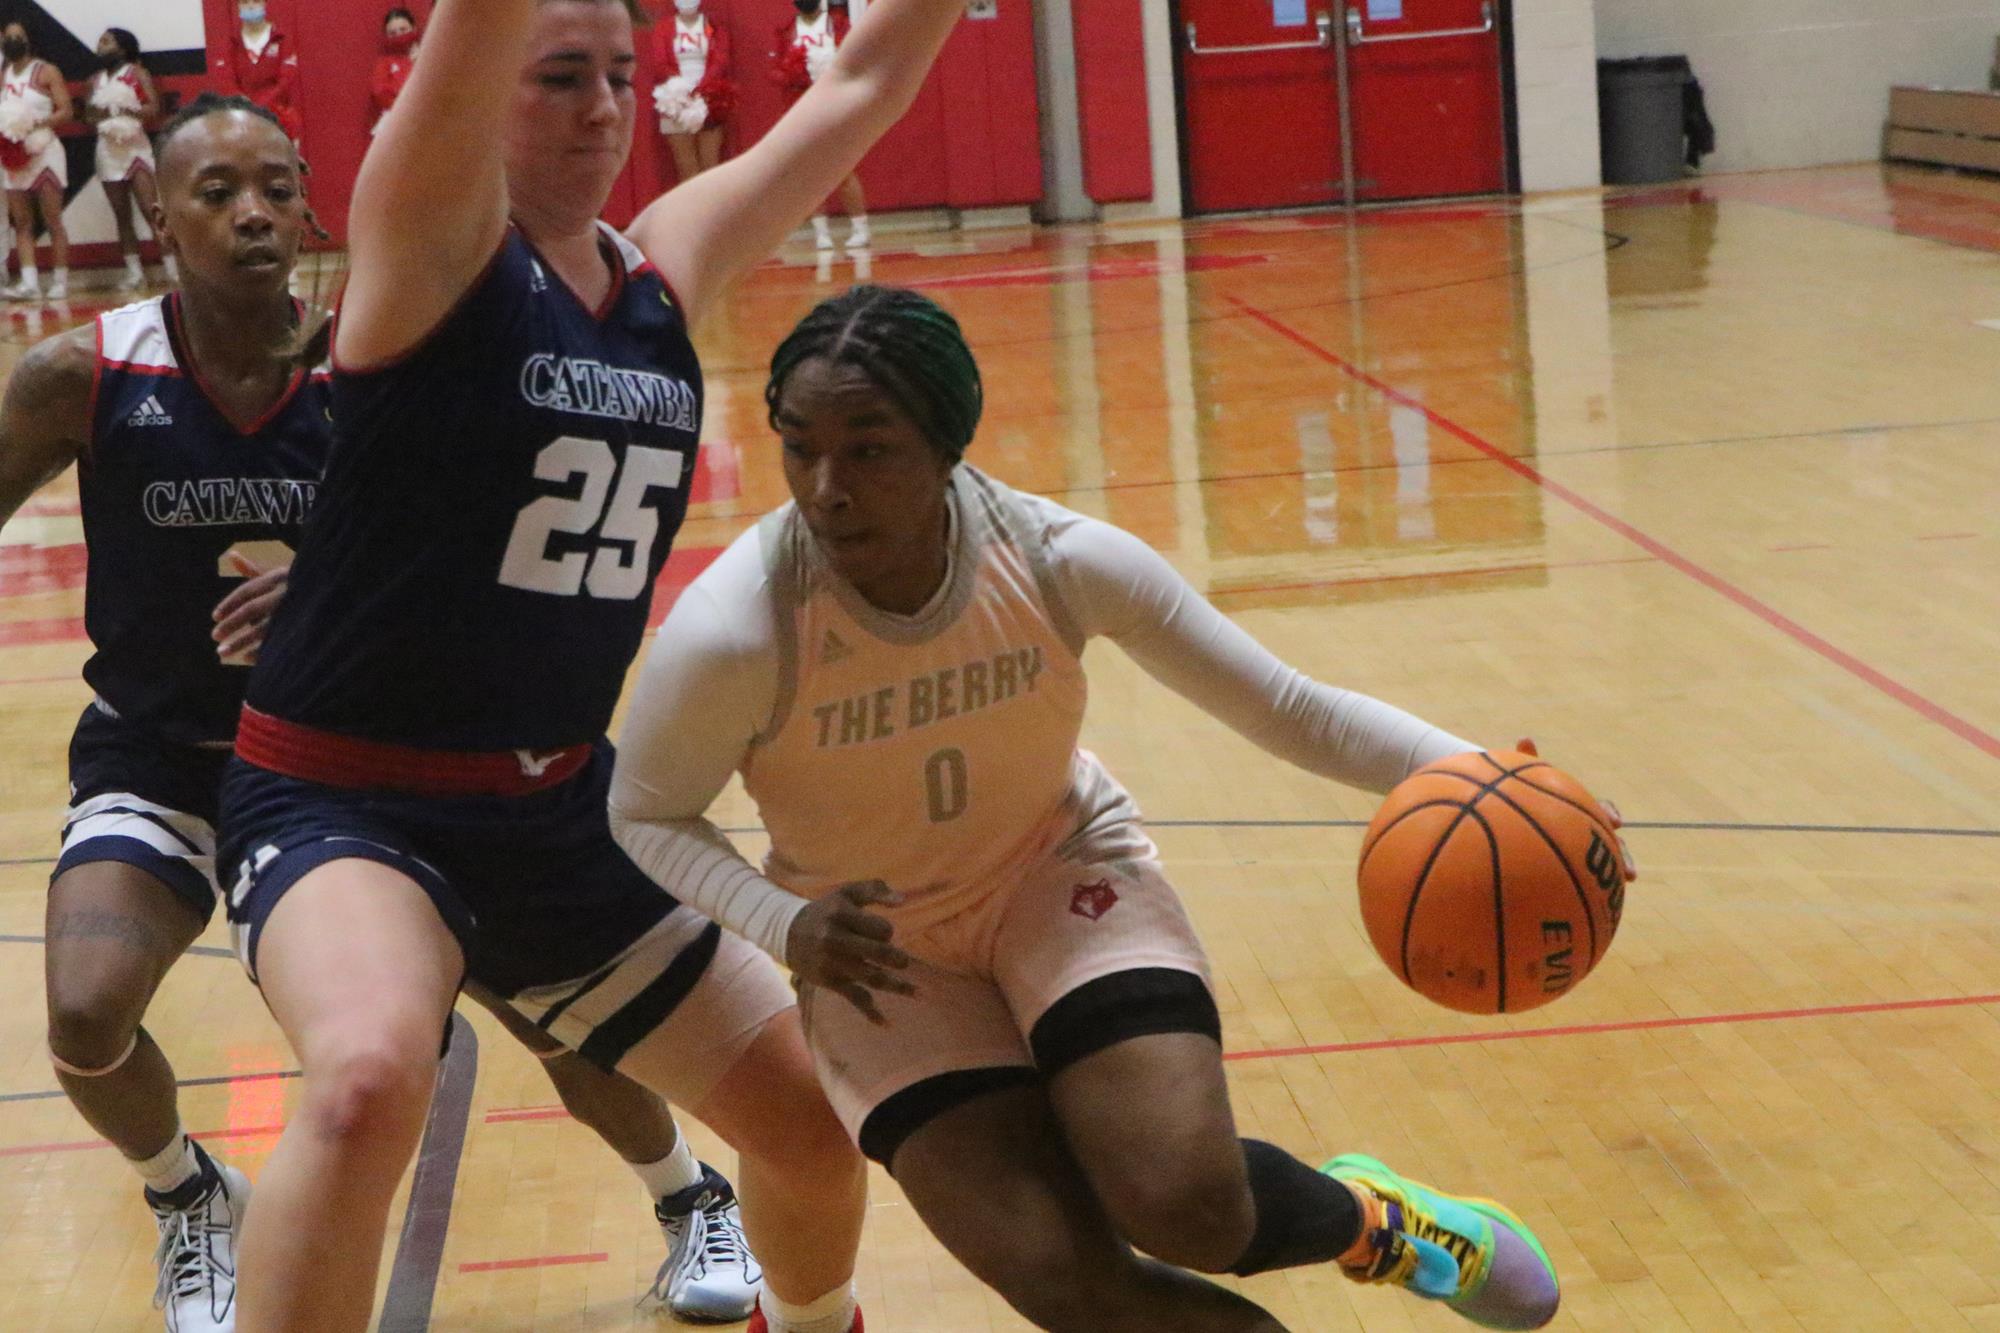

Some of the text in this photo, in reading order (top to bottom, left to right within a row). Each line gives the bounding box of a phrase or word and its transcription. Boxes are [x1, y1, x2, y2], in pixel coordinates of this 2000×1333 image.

[127, 414, 173, 427] adidas
[519, 352, 697, 433] CATAWBA
[497, 435, 684, 600] 25
[813, 646, 1043, 747] THE BERRY
[924, 747, 968, 824] 0
